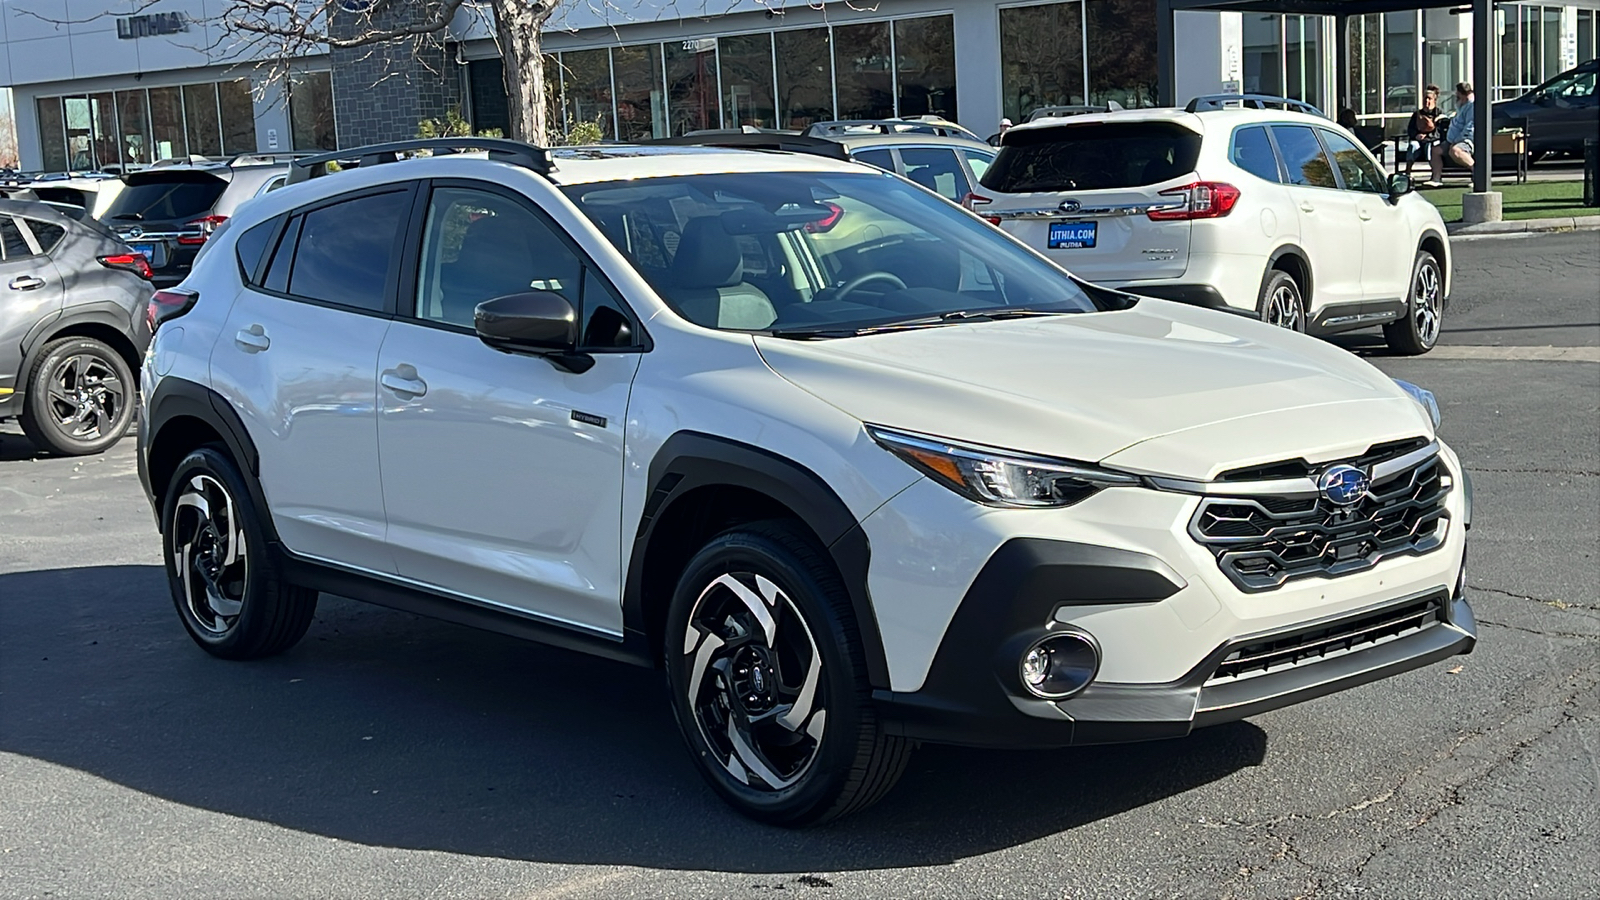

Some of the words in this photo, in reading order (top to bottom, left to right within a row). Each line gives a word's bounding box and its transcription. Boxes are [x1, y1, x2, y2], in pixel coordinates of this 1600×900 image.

[116, 11, 188, 39] LITHIA
[682, 40, 699, 50] 2270
[1050, 229, 1095, 241] LITHIA.COM
[575, 412, 601, 424] HYBRID
